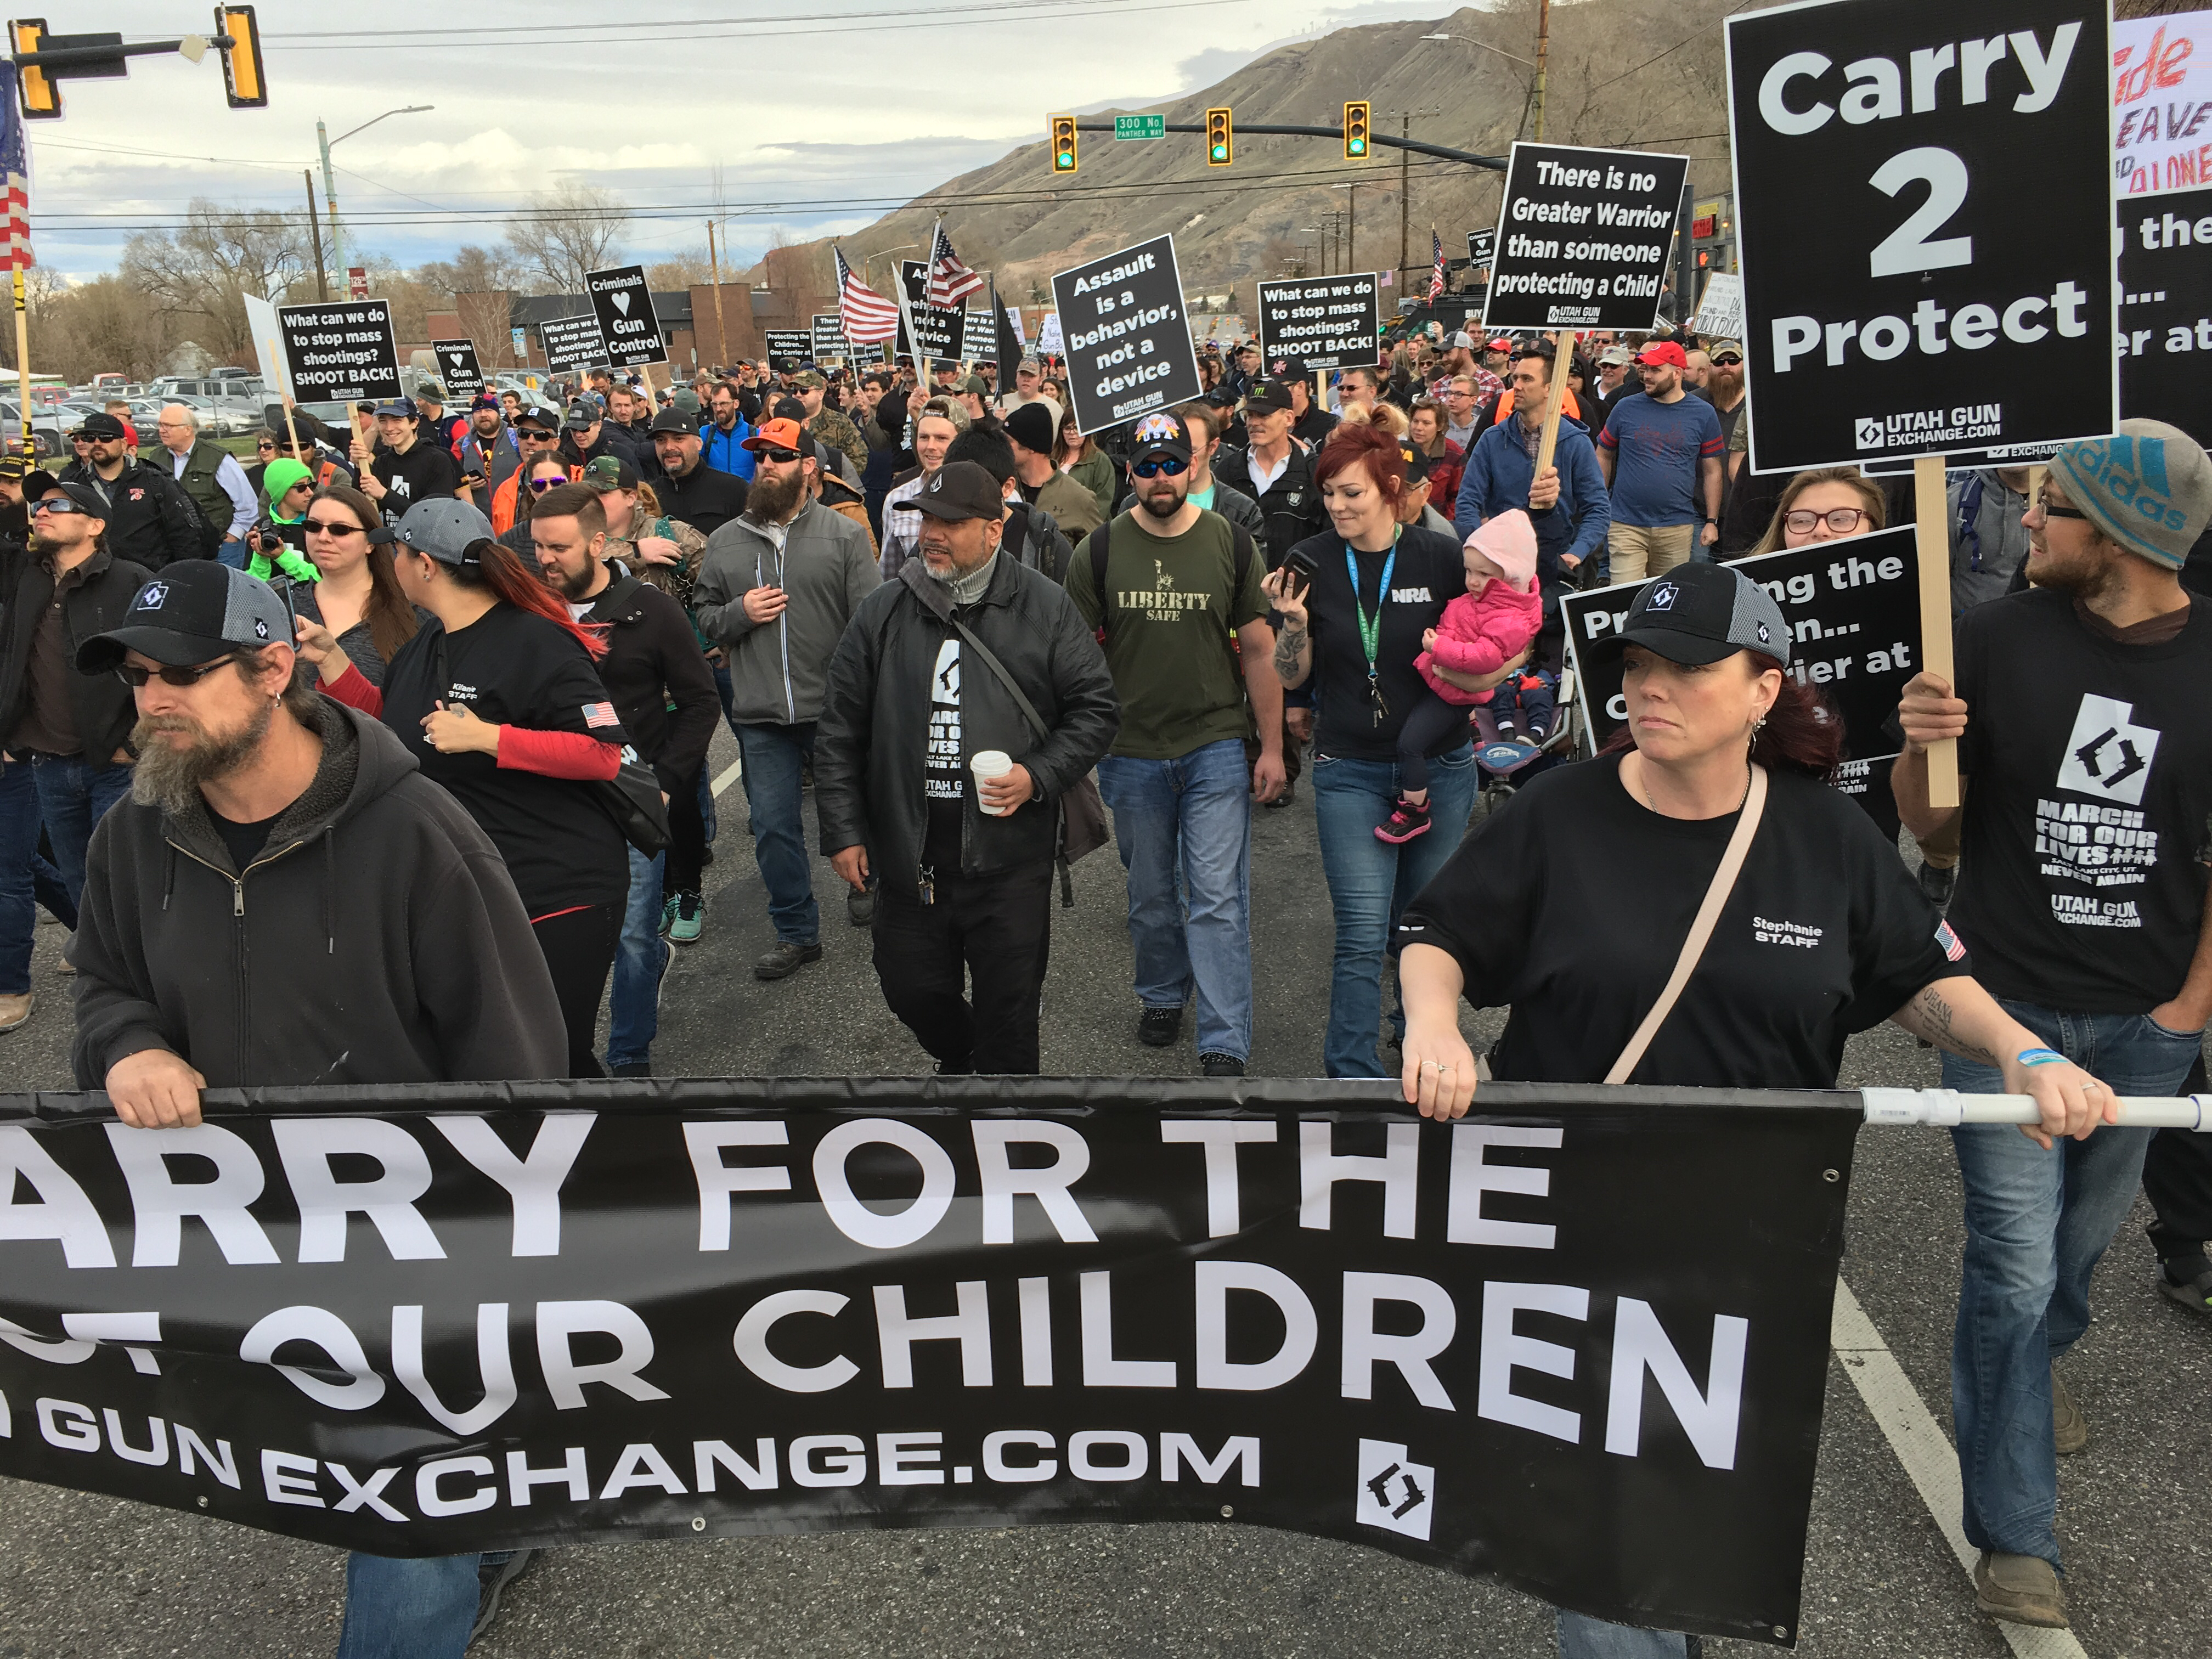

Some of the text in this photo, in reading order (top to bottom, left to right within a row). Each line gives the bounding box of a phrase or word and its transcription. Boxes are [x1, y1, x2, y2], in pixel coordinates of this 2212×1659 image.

[1758, 21, 2082, 135] Carry
[1120, 118, 1162, 129] 300 No.
[2115, 102, 2212, 150] EAVE
[1537, 161, 1656, 192] There is no
[1513, 197, 1592, 224] Greater
[1598, 202, 1672, 229] Warrior
[1868, 146, 1972, 278] 2
[2140, 213, 2212, 250] the
[1508, 234, 1661, 263] than someone
[591, 274, 643, 292] Criminals
[1074, 253, 1155, 297] Assault
[1264, 281, 1372, 302] What can we do
[1496, 272, 1660, 300] protecting a Child
[1096, 291, 1134, 315] is a
[1271, 302, 1366, 320] to stop mass
[1560, 306, 1601, 317] UTAH GUN
[283, 308, 385, 328] What can we do
[915, 316, 946, 328] not a
[1465, 309, 1482, 319] BUY
[1694, 313, 1718, 334] PUBLIC
[544, 324, 565, 334] What
[560, 333, 579, 341] stop
[580, 329, 601, 338] mass
[613, 319, 645, 335] Gun
[1070, 304, 1176, 351] behavior,
[1279, 319, 1360, 338] shootings?
[1771, 281, 2086, 373] Protect
[2165, 318, 2212, 353] at
[293, 331, 382, 347] to stop mass
[436, 344, 472, 352] Criminals
[555, 339, 599, 353] shootings?
[609, 335, 660, 354] Control
[1267, 336, 1373, 357] SHOOT BACK!
[303, 348, 379, 366] shootings?
[550, 353, 579, 364] SHOOT
[1096, 339, 1154, 370] not a
[295, 367, 394, 385] SHOOT BACK!
[450, 368, 473, 377] Gun
[1096, 362, 1171, 397] device
[447, 379, 483, 388] Control
[1124, 391, 1163, 410] UTAH GUN
[1125, 398, 1164, 415] EXCHANGE.COM
[1887, 403, 2001, 433] UTAH GUN
[1143, 430, 1173, 442] USA
[1887, 424, 2001, 447] EXCHANGE.COM
[2011, 444, 2064, 457] EXCHANG
[1827, 556, 1904, 592] the
[1118, 591, 1211, 611] LIBERTY
[1391, 587, 1431, 603] NRA
[1146, 610, 1181, 622] SAFE
[1866, 642, 1911, 674] at
[448, 690, 478, 700] STAFF
[930, 710, 960, 725] ARC
[928, 740, 960, 754] VES
[2036, 798, 2145, 828] MARCH
[2036, 817, 2158, 848] FOR OUR
[2035, 834, 2109, 865] LIVES
[2041, 864, 2146, 887] NEVER AGAIN
[2051, 857, 2073, 867] SALT
[2075, 865, 2099, 874] LAKE
[2051, 894, 2138, 918] UTAH GUN
[1752, 916, 1822, 936] Stephanie
[2052, 910, 2141, 928] EXCHANGE.COM
[1755, 931, 1819, 948] STAFF
[0, 1112, 1564, 1269] ARRY FOR THE
[240, 1261, 1750, 1472] OUR CHILDREN
[37, 1395, 1260, 1522] GUN EXCHANGE.COM
